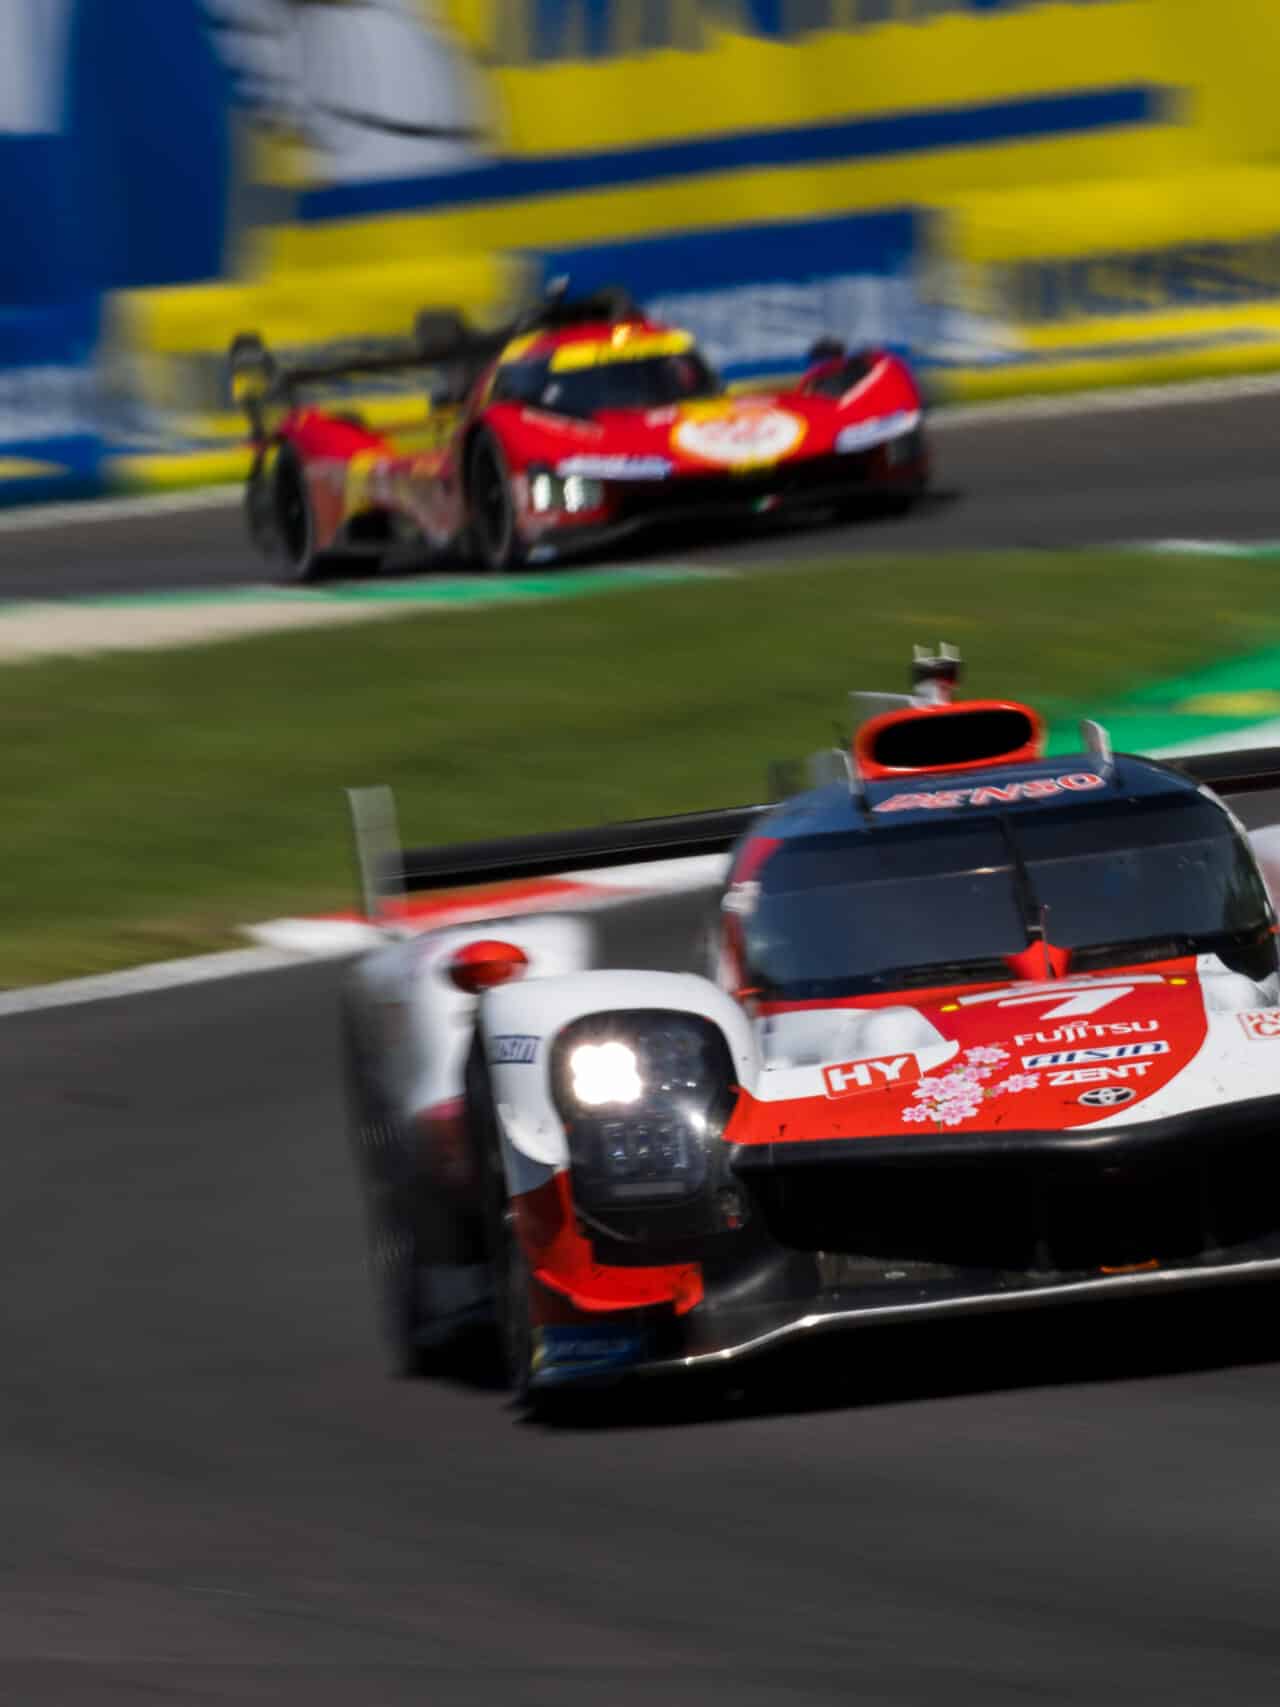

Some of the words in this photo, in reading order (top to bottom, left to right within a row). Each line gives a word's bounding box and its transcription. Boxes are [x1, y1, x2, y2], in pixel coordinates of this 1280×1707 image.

[872, 773, 1106, 812] DENSO
[996, 985, 1135, 1021] 7
[1014, 1020, 1160, 1047] FUJITSU
[828, 1056, 910, 1092] HY
[1047, 1061, 1154, 1087] ZENT
